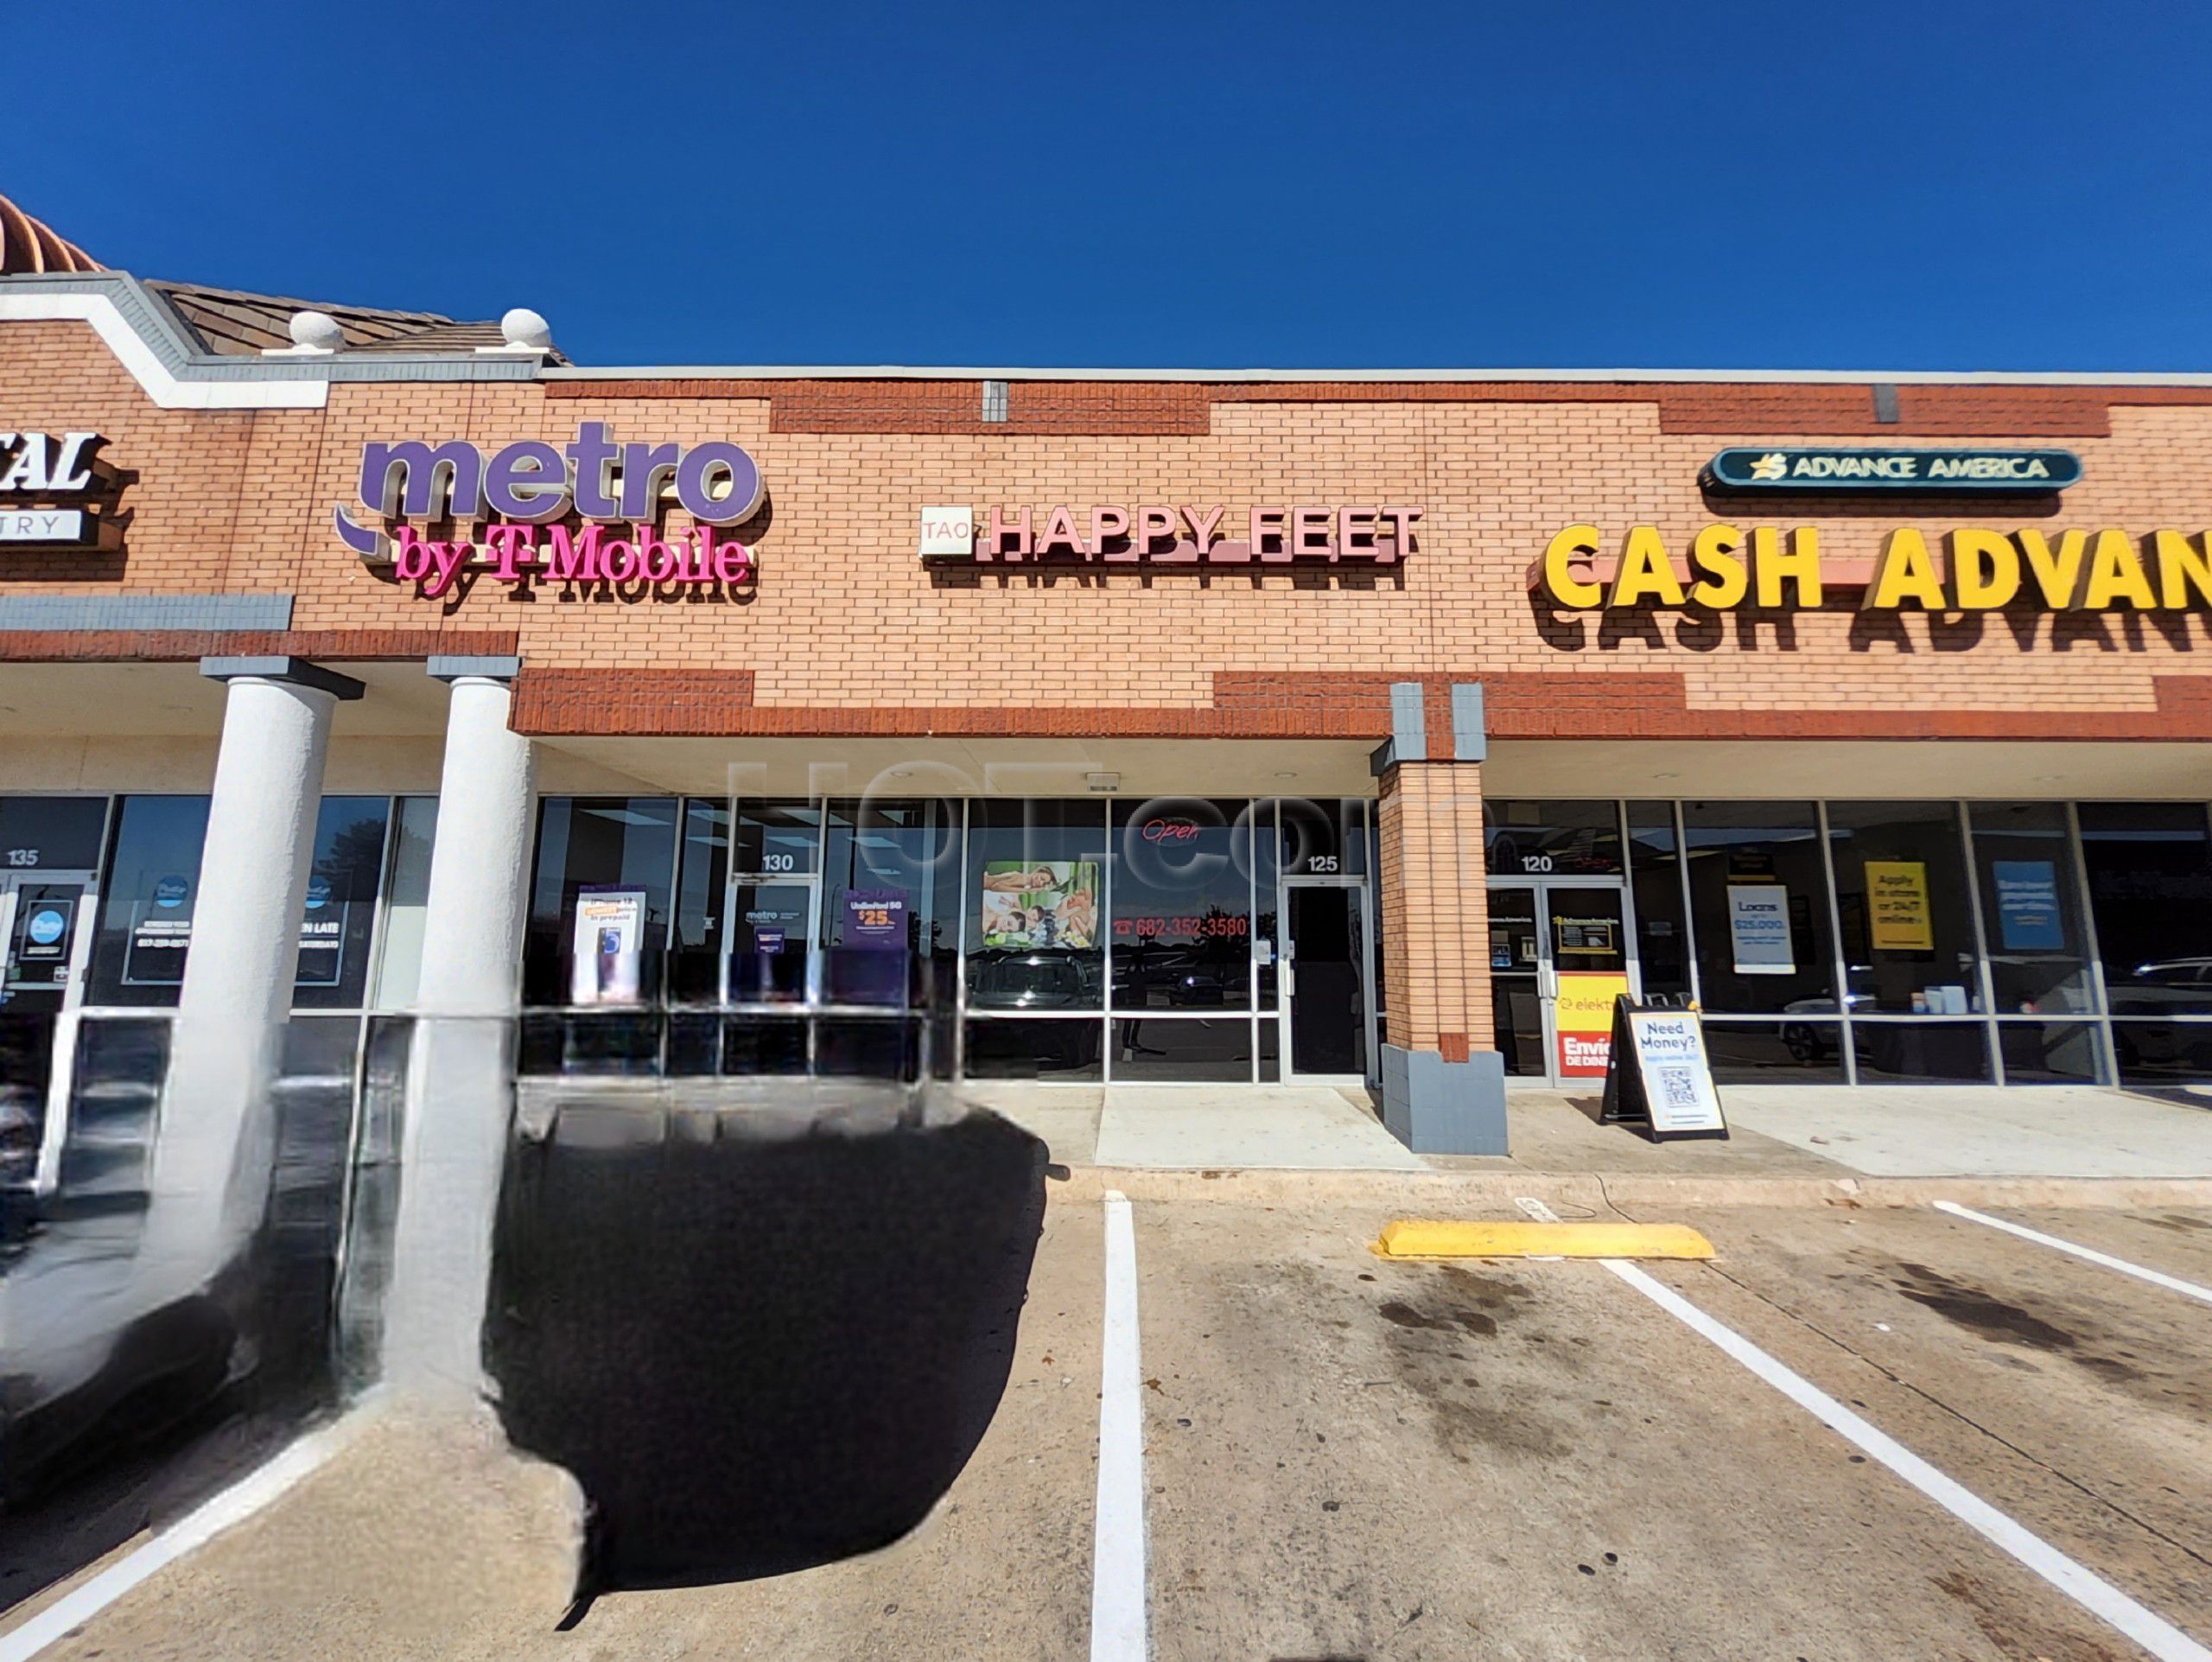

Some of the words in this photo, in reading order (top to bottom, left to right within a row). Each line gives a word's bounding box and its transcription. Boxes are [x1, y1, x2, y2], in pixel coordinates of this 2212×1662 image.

[359, 421, 760, 523] metro
[1792, 456, 1918, 479] ADVANCE
[1927, 456, 2050, 479] AMERICA
[922, 520, 969, 539] TAO
[989, 505, 1225, 557] HAPPY
[1249, 506, 1425, 557] FEET
[395, 525, 469, 597] by
[1544, 524, 1825, 608] CASH
[1872, 528, 2212, 610] ADVAN
[1141, 818, 1199, 842] Open
[7, 850, 39, 865] 135
[762, 854, 793, 870] 130
[1307, 856, 1338, 872] 125
[1521, 856, 1553, 872] 120
[1738, 901, 1778, 912] Loans
[314, 921, 339, 933] LATE
[1135, 917, 1247, 937] 682-352-3580
[1575, 997, 1614, 1010] elekt
[1646, 1021, 1684, 1035] Need
[1640, 1035, 1696, 1052] Money?
